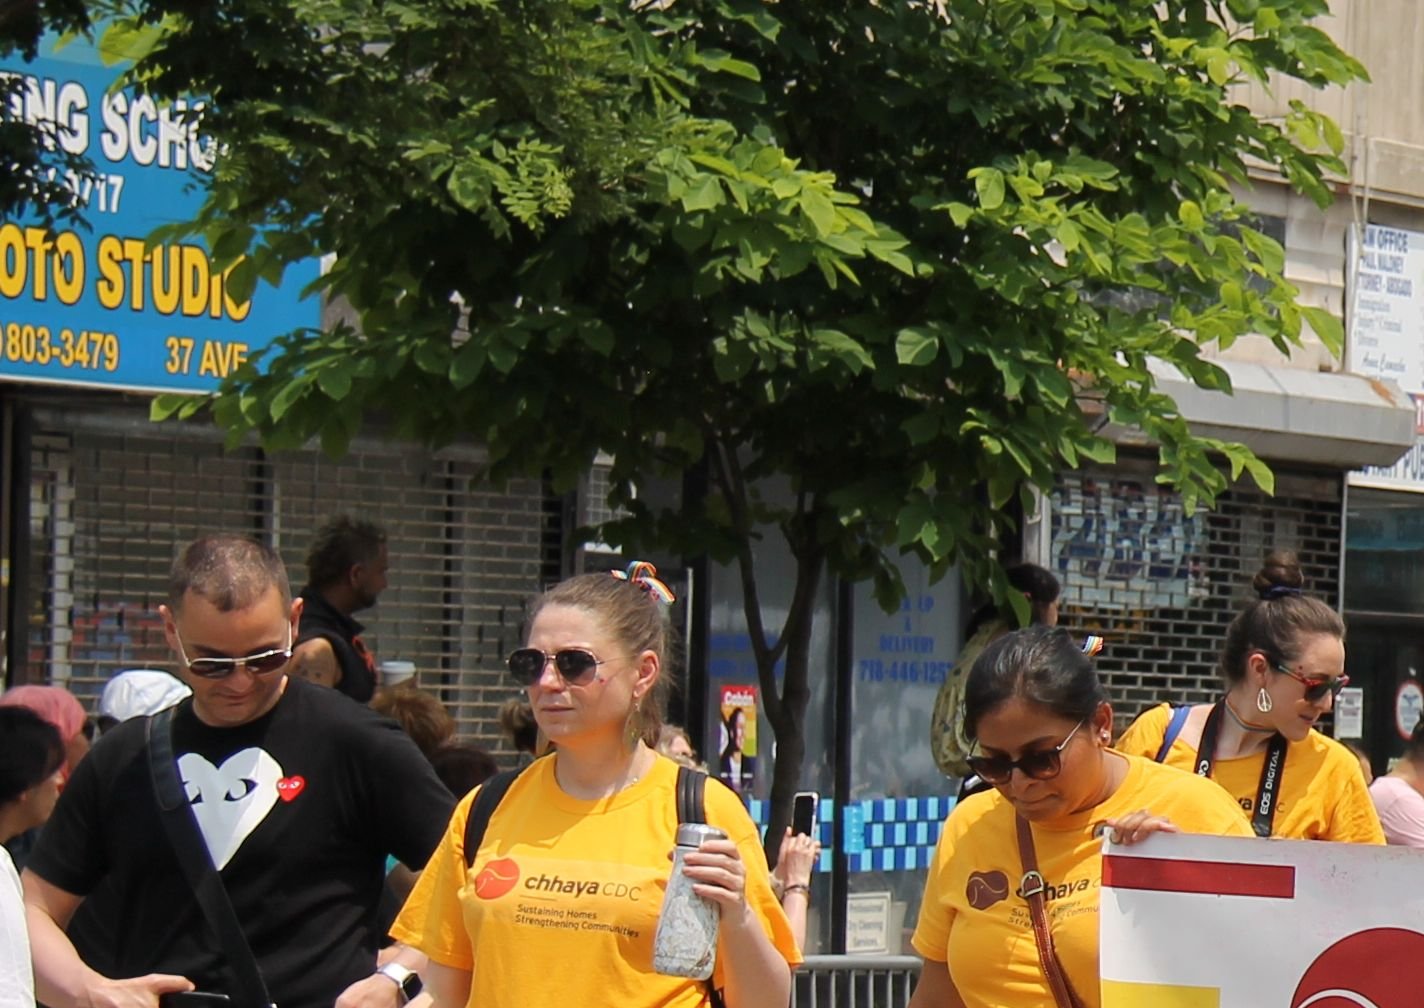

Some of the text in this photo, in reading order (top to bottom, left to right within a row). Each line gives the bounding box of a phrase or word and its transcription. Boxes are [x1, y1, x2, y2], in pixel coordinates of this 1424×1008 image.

[165, 336, 195, 375] 37
[1260, 750, 1280, 815] EOS DIGITAL
[524, 874, 642, 902] chhaya CDC
[518, 904, 597, 919] Sustaining Homes
[515, 914, 640, 938] Strengthening Communities
